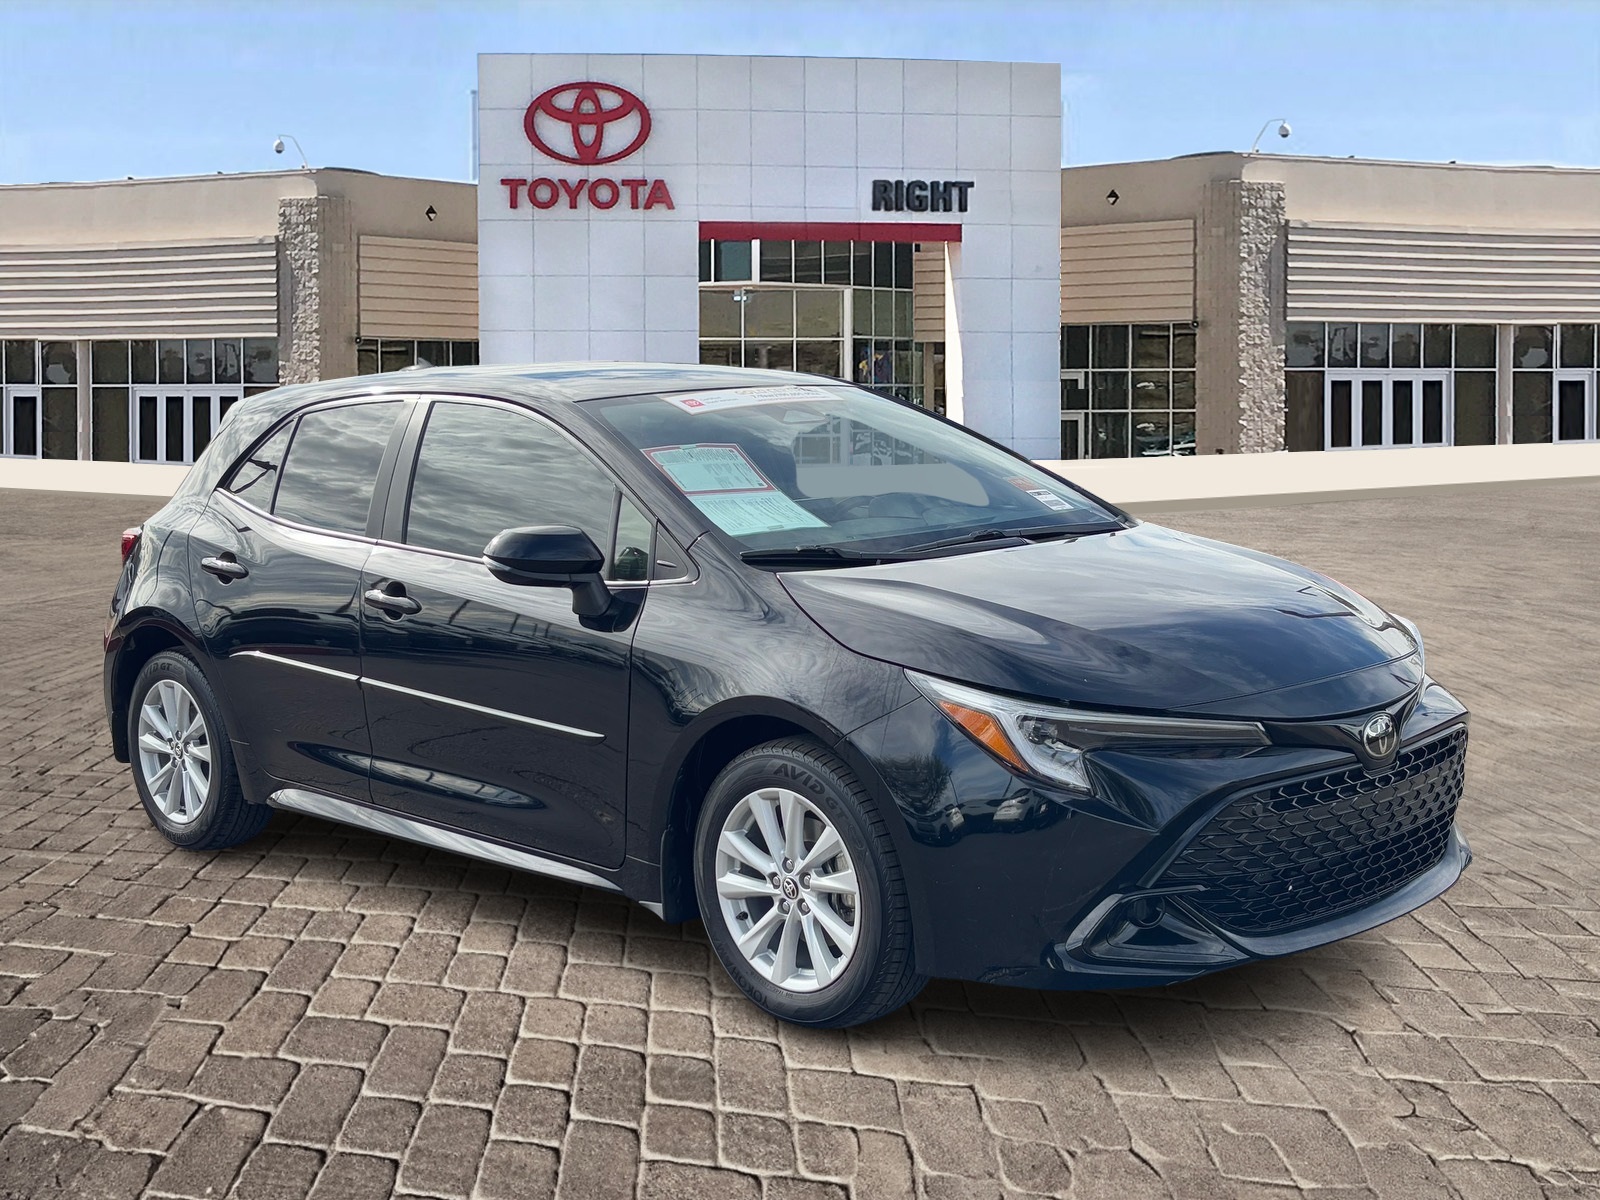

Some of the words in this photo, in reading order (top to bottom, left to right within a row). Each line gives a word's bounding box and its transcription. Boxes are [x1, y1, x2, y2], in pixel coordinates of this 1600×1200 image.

[500, 177, 675, 210] TOYOTA
[872, 179, 975, 212] RIGHT
[773, 763, 826, 794] AVID
[824, 796, 849, 822] GT
